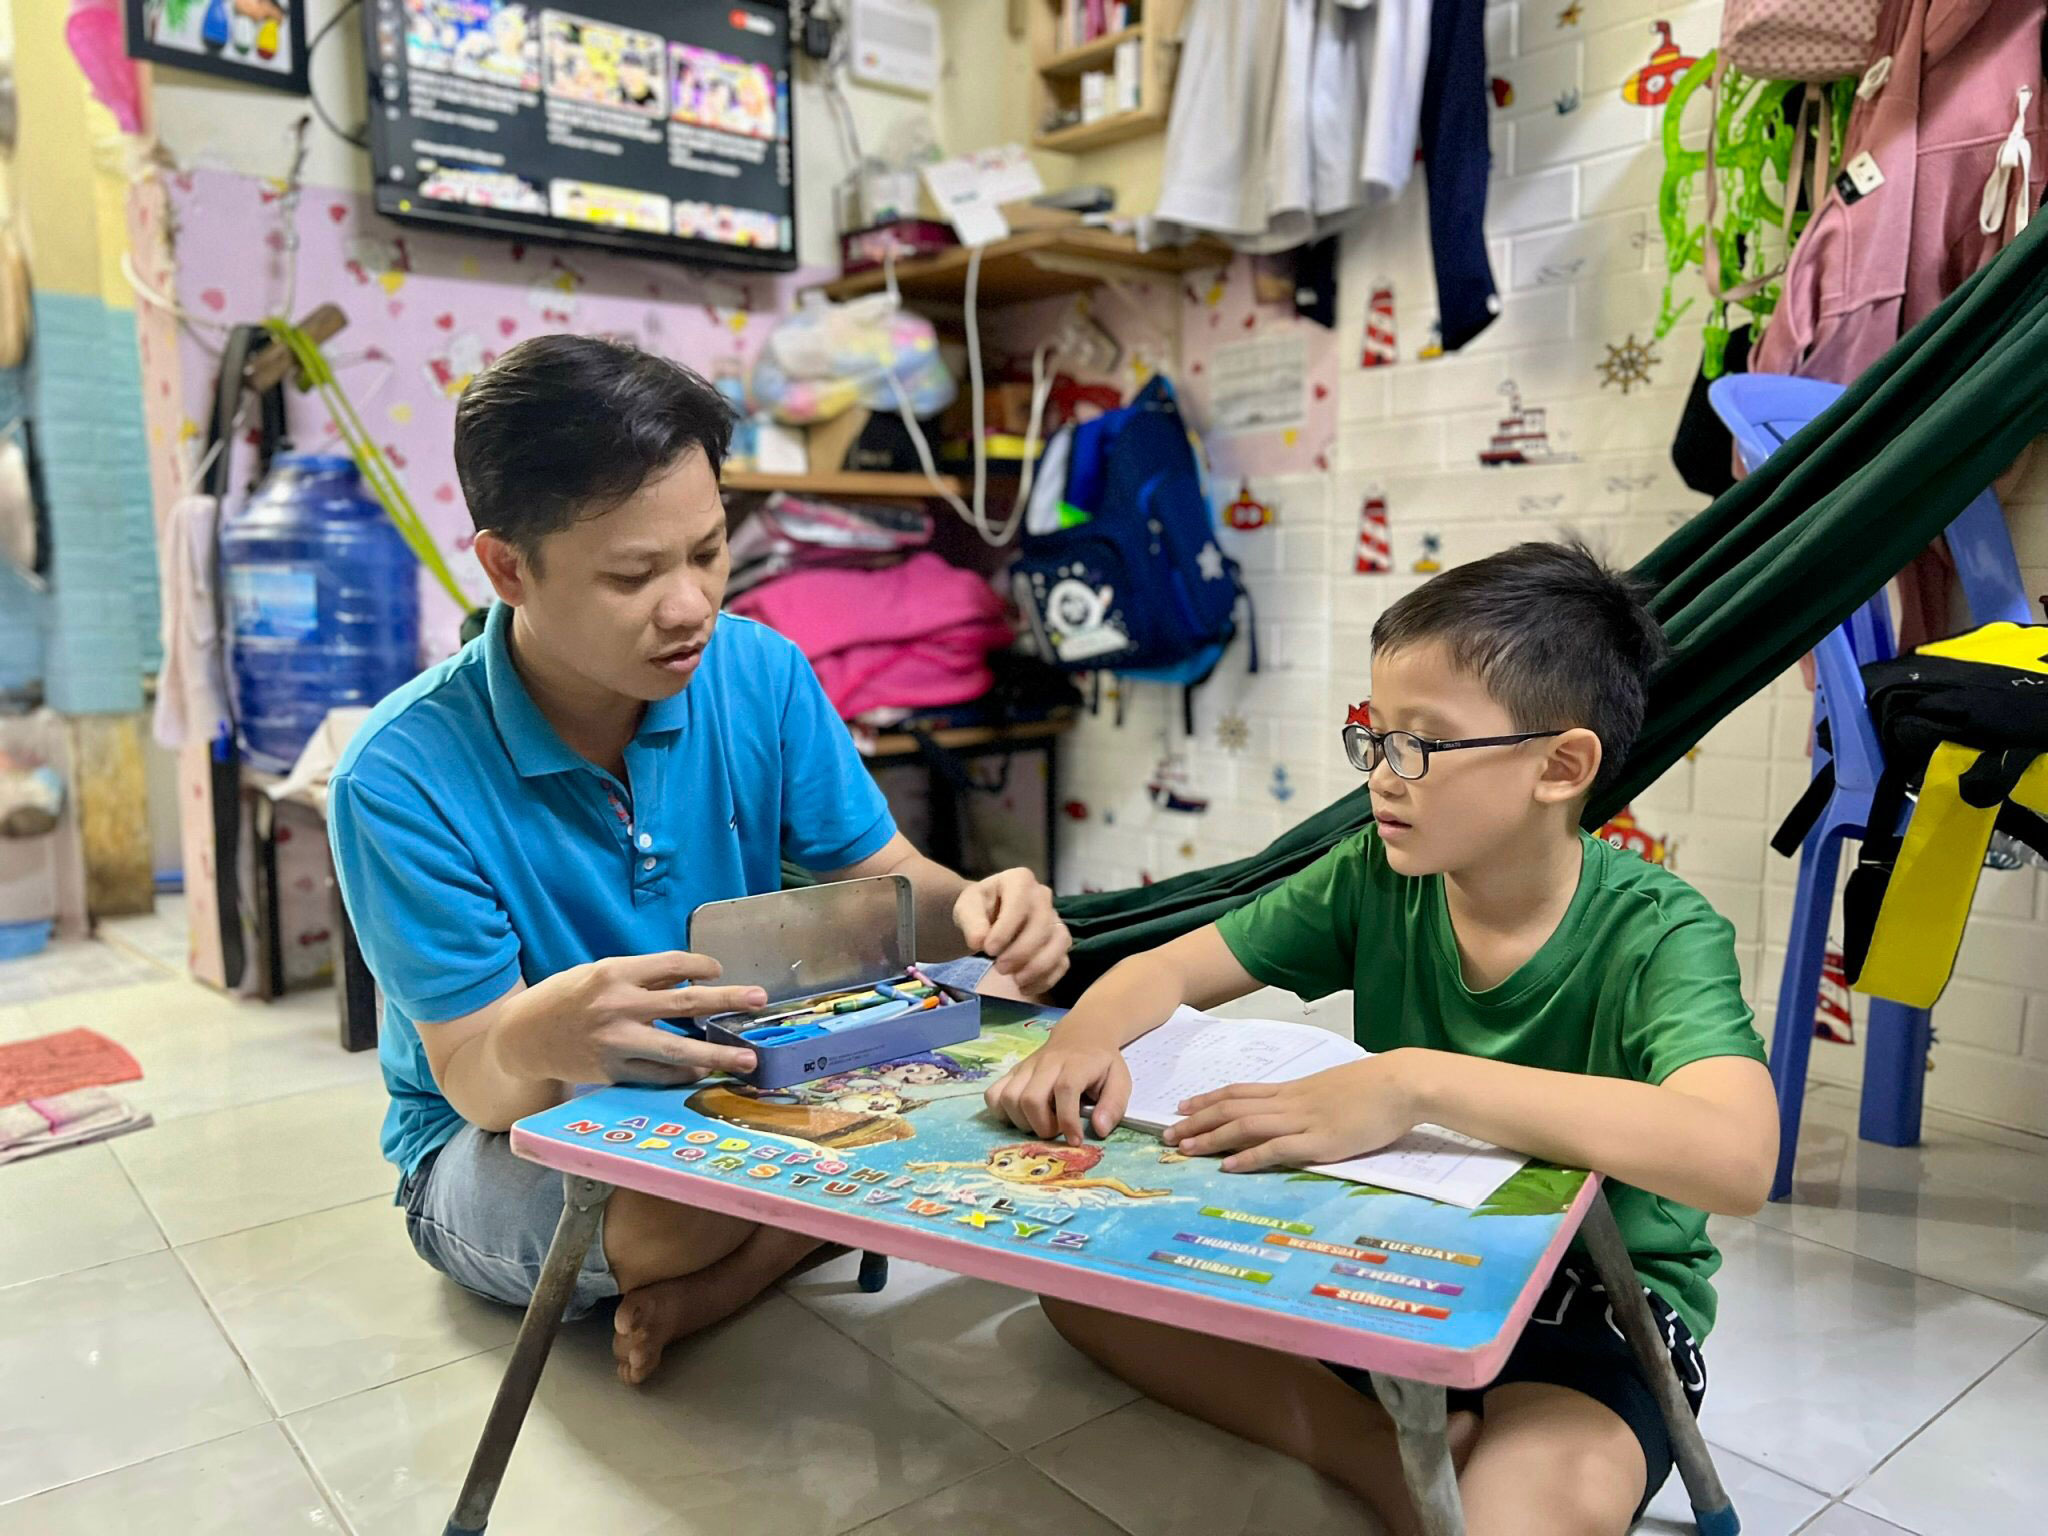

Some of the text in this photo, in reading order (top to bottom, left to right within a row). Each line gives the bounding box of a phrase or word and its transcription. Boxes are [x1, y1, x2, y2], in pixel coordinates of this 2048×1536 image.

[803, 1060, 816, 1072] DC
[617, 1116, 649, 1129] A
[652, 1123, 685, 1136] B
[715, 1138, 751, 1151] D
[749, 1145, 786, 1160] E
[783, 1152, 812, 1165] F
[814, 1160, 848, 1175] G
[849, 1167, 889, 1184] H
[990, 1197, 1017, 1214] L
[564, 1120, 604, 1134] N
[603, 1130, 636, 1142] O
[635, 1137, 672, 1150] P
[672, 1147, 707, 1160] Q
[709, 1155, 746, 1171] R
[746, 1164, 782, 1178] S
[790, 1172, 821, 1186] T
[822, 1181, 860, 1195] U
[905, 1197, 954, 1216] W
[953, 1210, 1004, 1228] X
[1012, 1219, 1050, 1237] Y
[1048, 1230, 1088, 1248] Z
[1220, 1209, 1294, 1230] MONDAY
[1195, 1235, 1267, 1256] THURSDAY
[1287, 1237, 1365, 1259] WEDNESDAY
[1380, 1240, 1457, 1261] TUESDAY
[1174, 1255, 1249, 1277] SATURDAY
[1356, 1267, 1441, 1290] FRIDAY
[1336, 1288, 1425, 1314] SUNDAY
